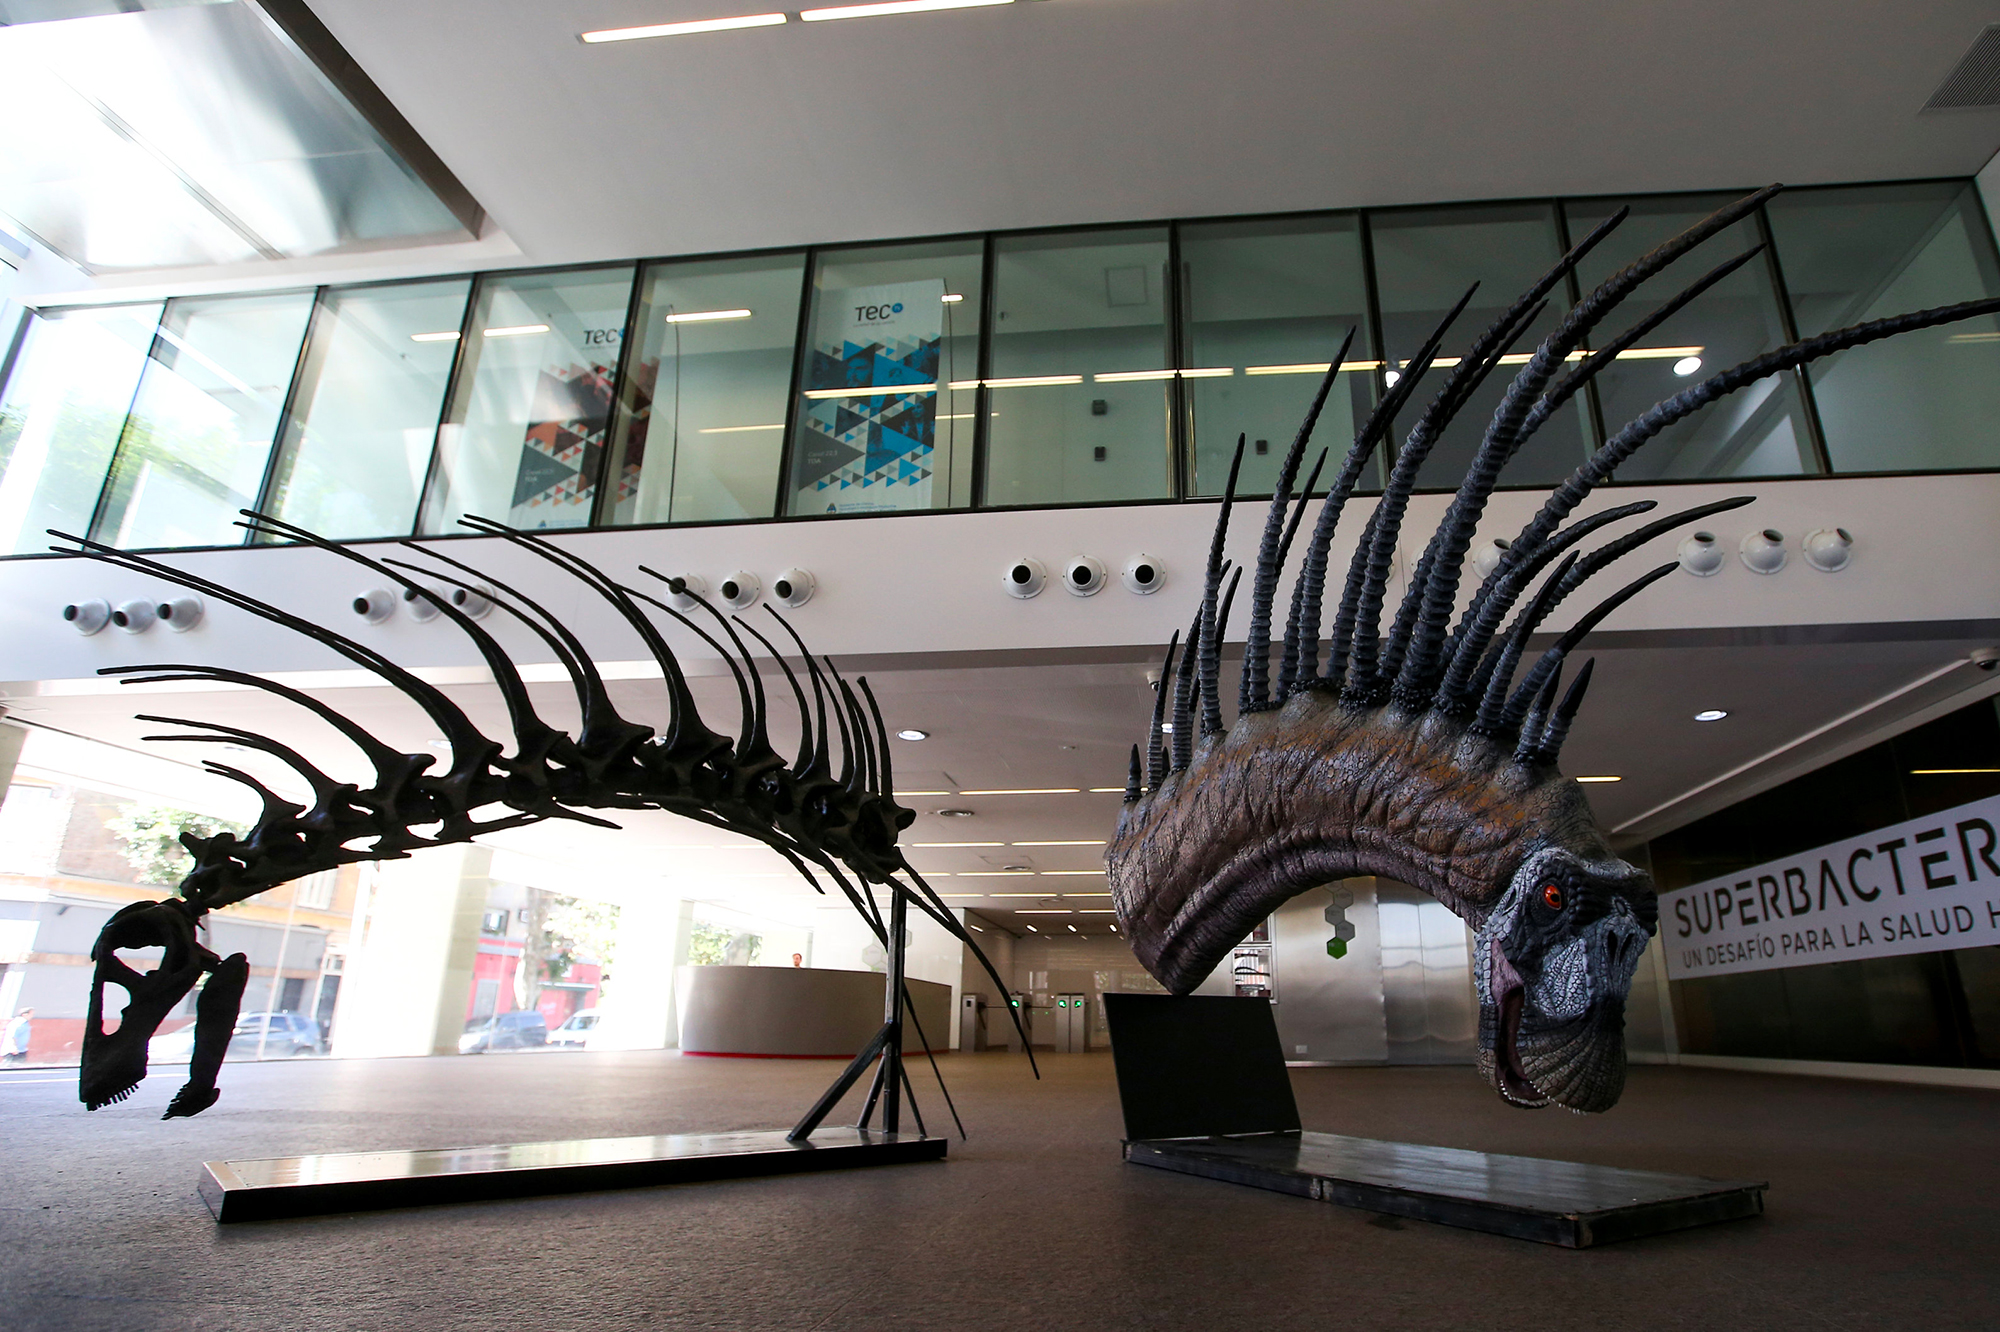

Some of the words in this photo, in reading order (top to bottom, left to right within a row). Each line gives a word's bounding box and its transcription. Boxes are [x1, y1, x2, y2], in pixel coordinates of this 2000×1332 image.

[1675, 818, 2000, 938] SUPERBACTER
[1683, 949, 1703, 968] UN
[1707, 933, 1775, 966] DESAFÍO
[1781, 927, 1836, 955] PARA
[1842, 920, 1873, 947] LA
[1881, 905, 1974, 942] SALUD
